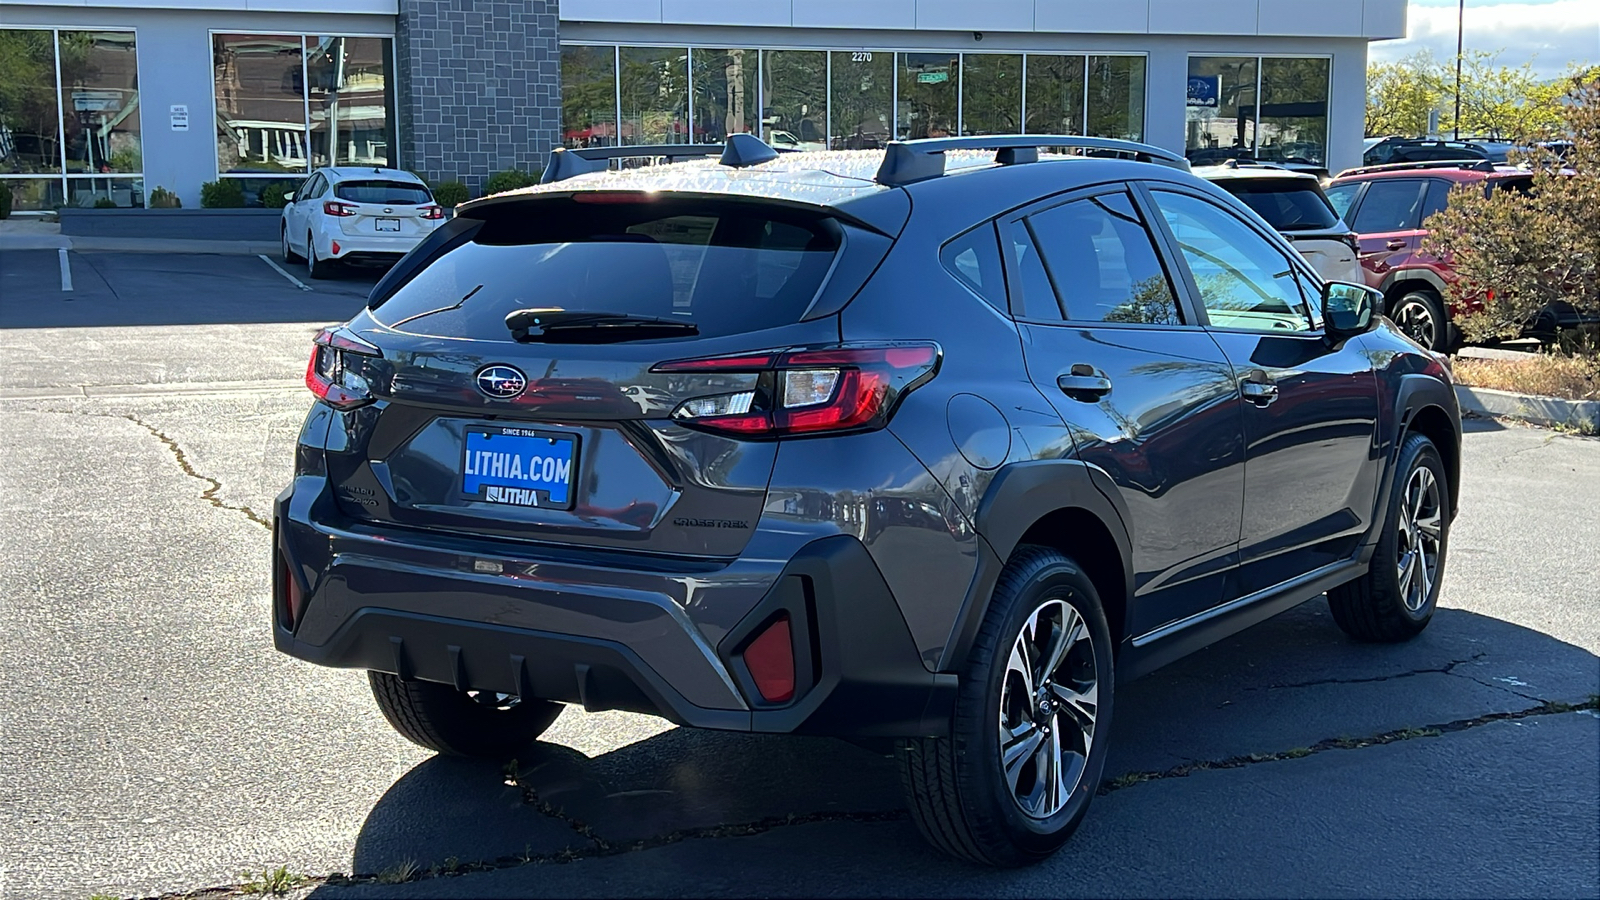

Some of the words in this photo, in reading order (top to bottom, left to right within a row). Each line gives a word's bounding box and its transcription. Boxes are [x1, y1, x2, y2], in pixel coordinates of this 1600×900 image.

[852, 52, 872, 62] 2270
[502, 427, 520, 436] SINCE
[521, 429, 535, 437] 1946
[464, 449, 571, 485] LITHIA.COM
[498, 486, 538, 507] LITHIA
[673, 517, 749, 529] CROSSTREK
